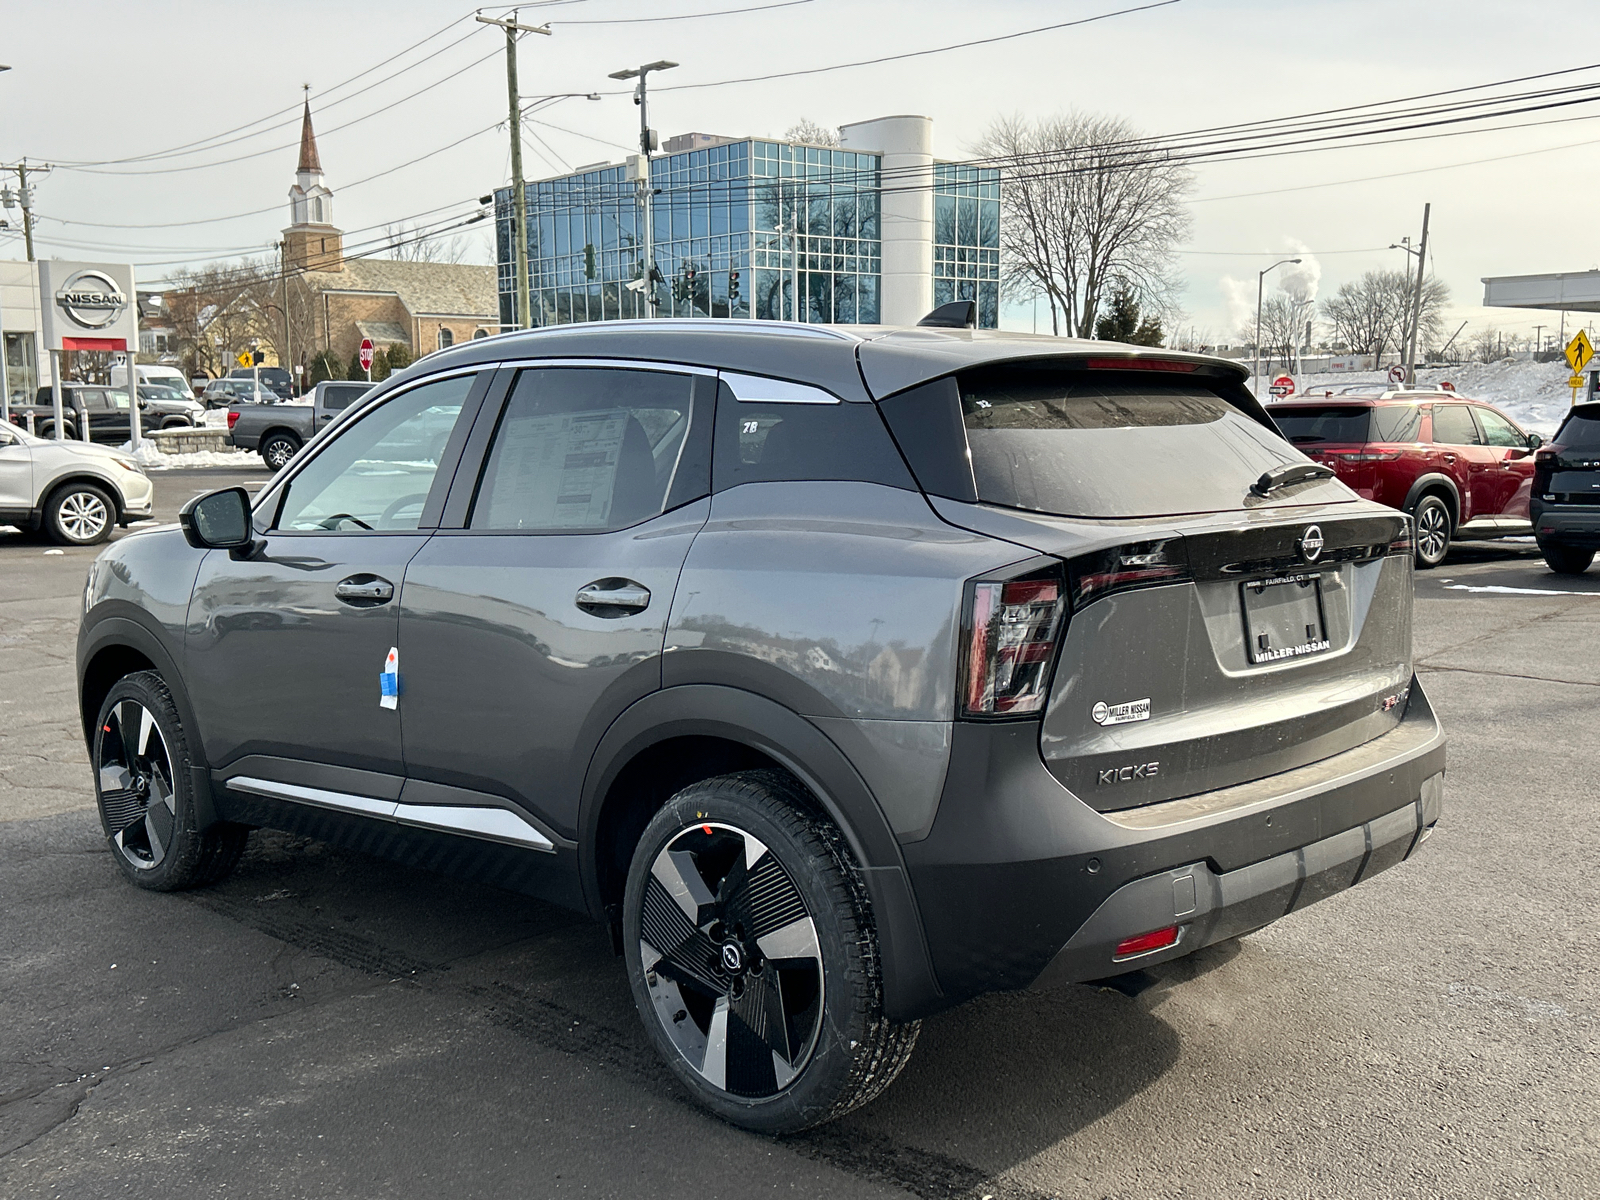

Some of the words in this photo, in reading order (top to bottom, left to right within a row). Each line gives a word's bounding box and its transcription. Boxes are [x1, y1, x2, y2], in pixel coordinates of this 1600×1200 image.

[65, 294, 122, 304] NISSAN
[361, 348, 373, 361] STOP
[1255, 647, 1294, 663] MILLER
[1294, 640, 1330, 655] NISSAN
[1109, 705, 1130, 718] MILLER
[1130, 702, 1150, 715] NISSAN
[1098, 761, 1160, 785] KICKS
